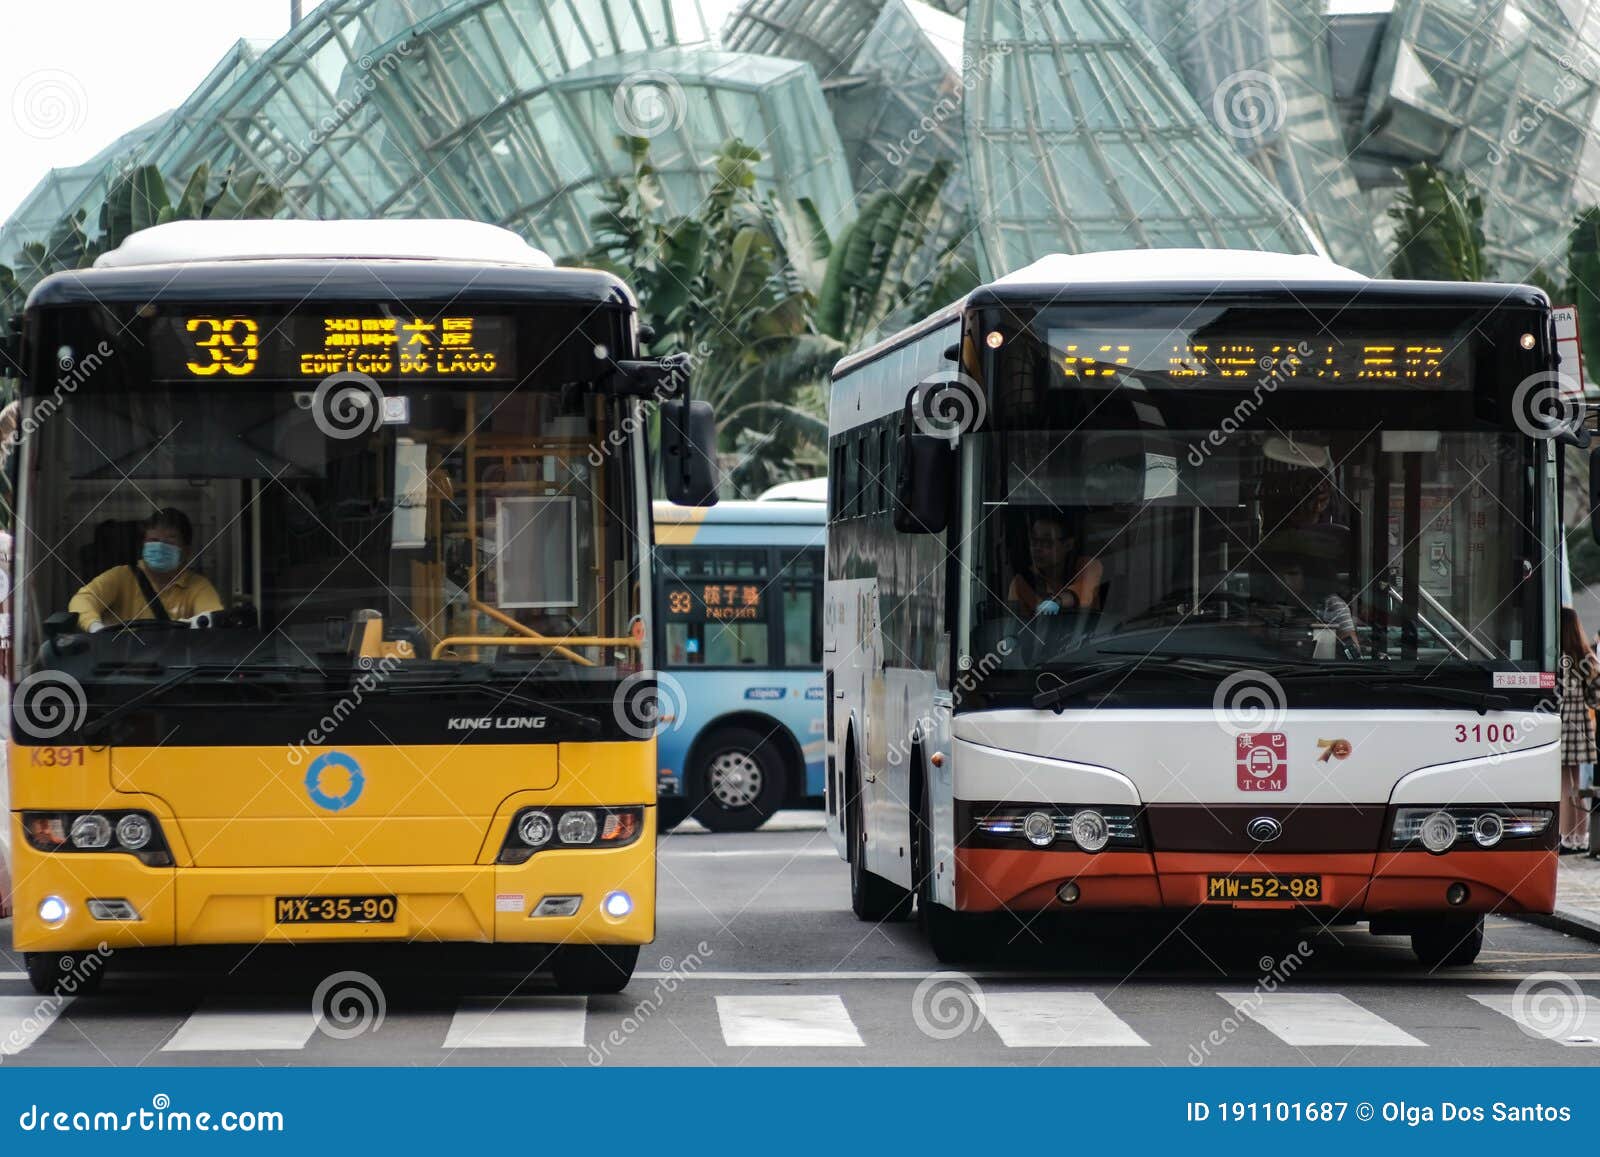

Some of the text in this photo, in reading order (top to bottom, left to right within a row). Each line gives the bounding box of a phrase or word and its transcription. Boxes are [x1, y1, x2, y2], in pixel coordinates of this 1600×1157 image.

[1551, 312, 1572, 321] EIRA
[324, 317, 474, 350] 湖畔大廈
[186, 315, 259, 375] 39
[400, 353, 428, 373] DO
[437, 353, 497, 373] LAGO
[669, 591, 692, 614] 33
[448, 716, 547, 730] KING LONG
[1455, 723, 1515, 743] 3100
[30, 747, 85, 767] K391
[1209, 877, 1319, 898] MW-52-98
[277, 899, 395, 921] MX-35-90
